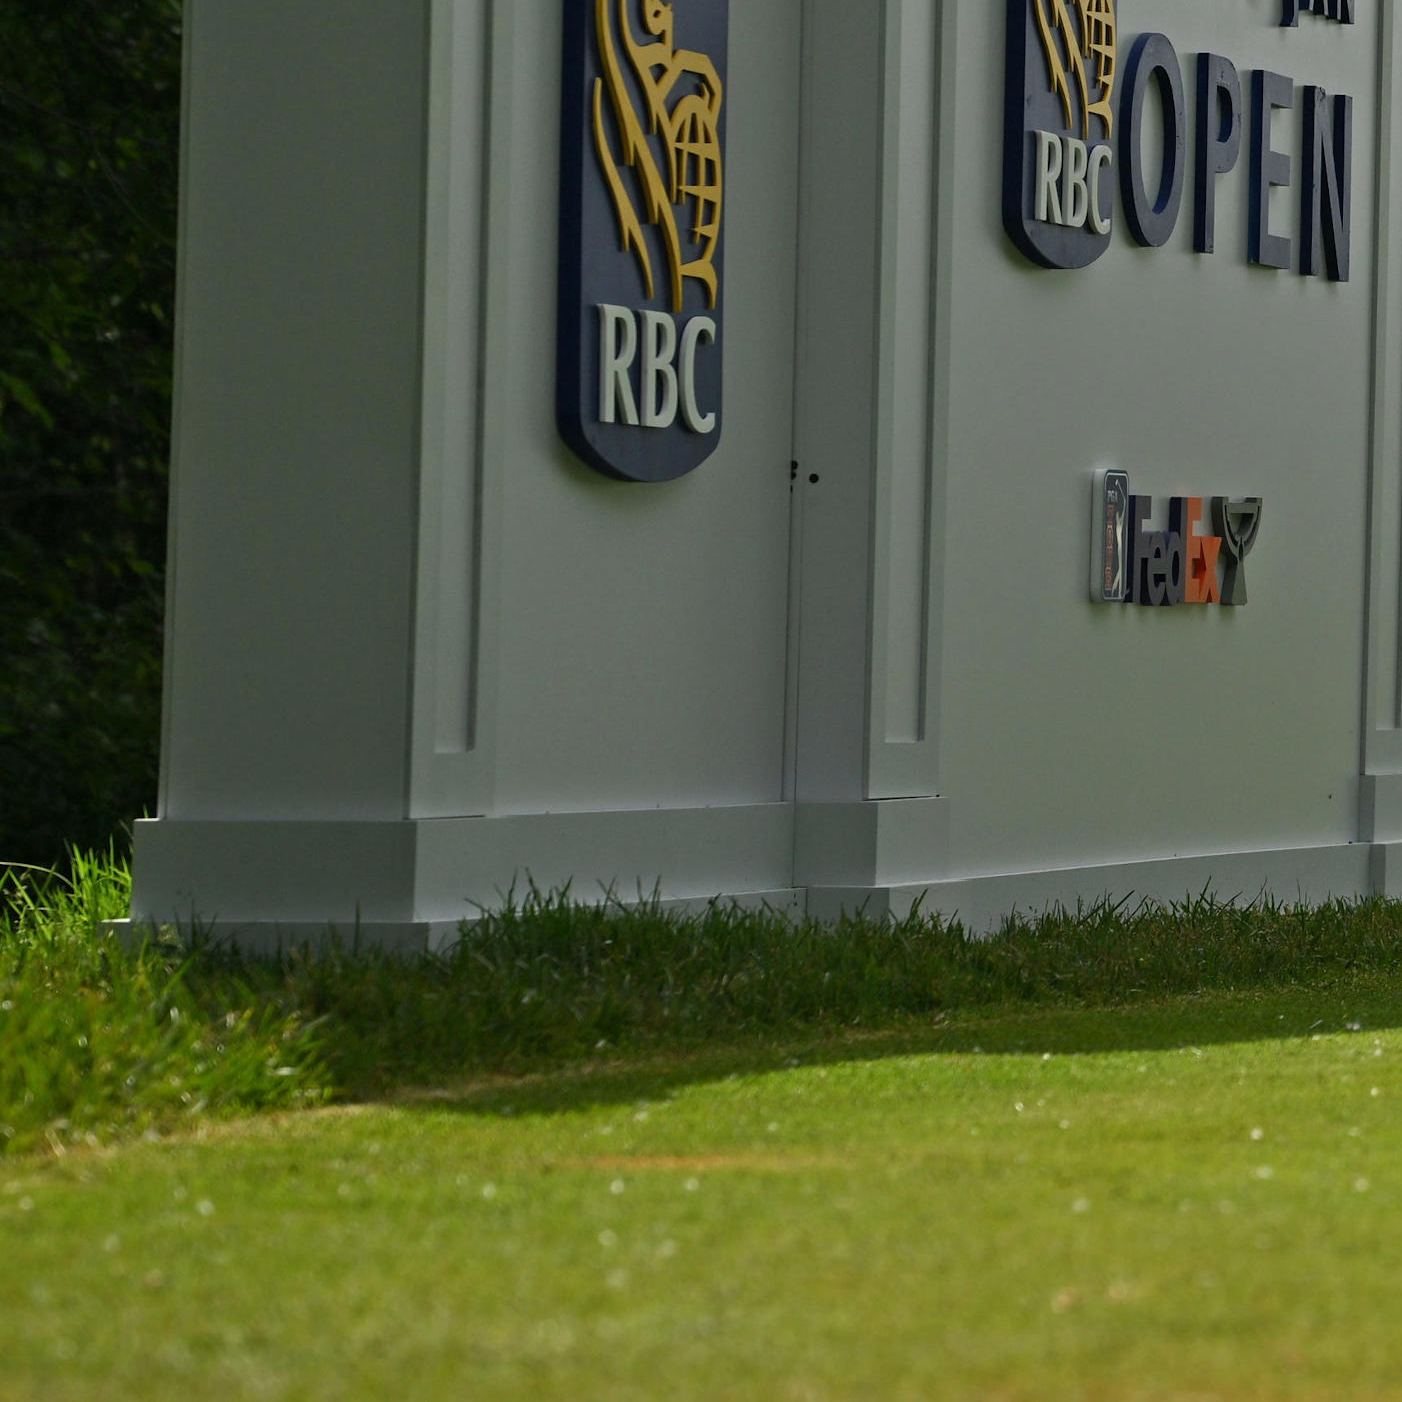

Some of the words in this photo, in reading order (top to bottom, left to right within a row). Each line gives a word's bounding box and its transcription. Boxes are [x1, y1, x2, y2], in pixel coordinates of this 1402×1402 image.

[1034, 129, 1113, 235] RBC
[1119, 32, 1353, 283] OPEN
[597, 302, 717, 435] RBC
[1126, 494, 1223, 607] FedEx
